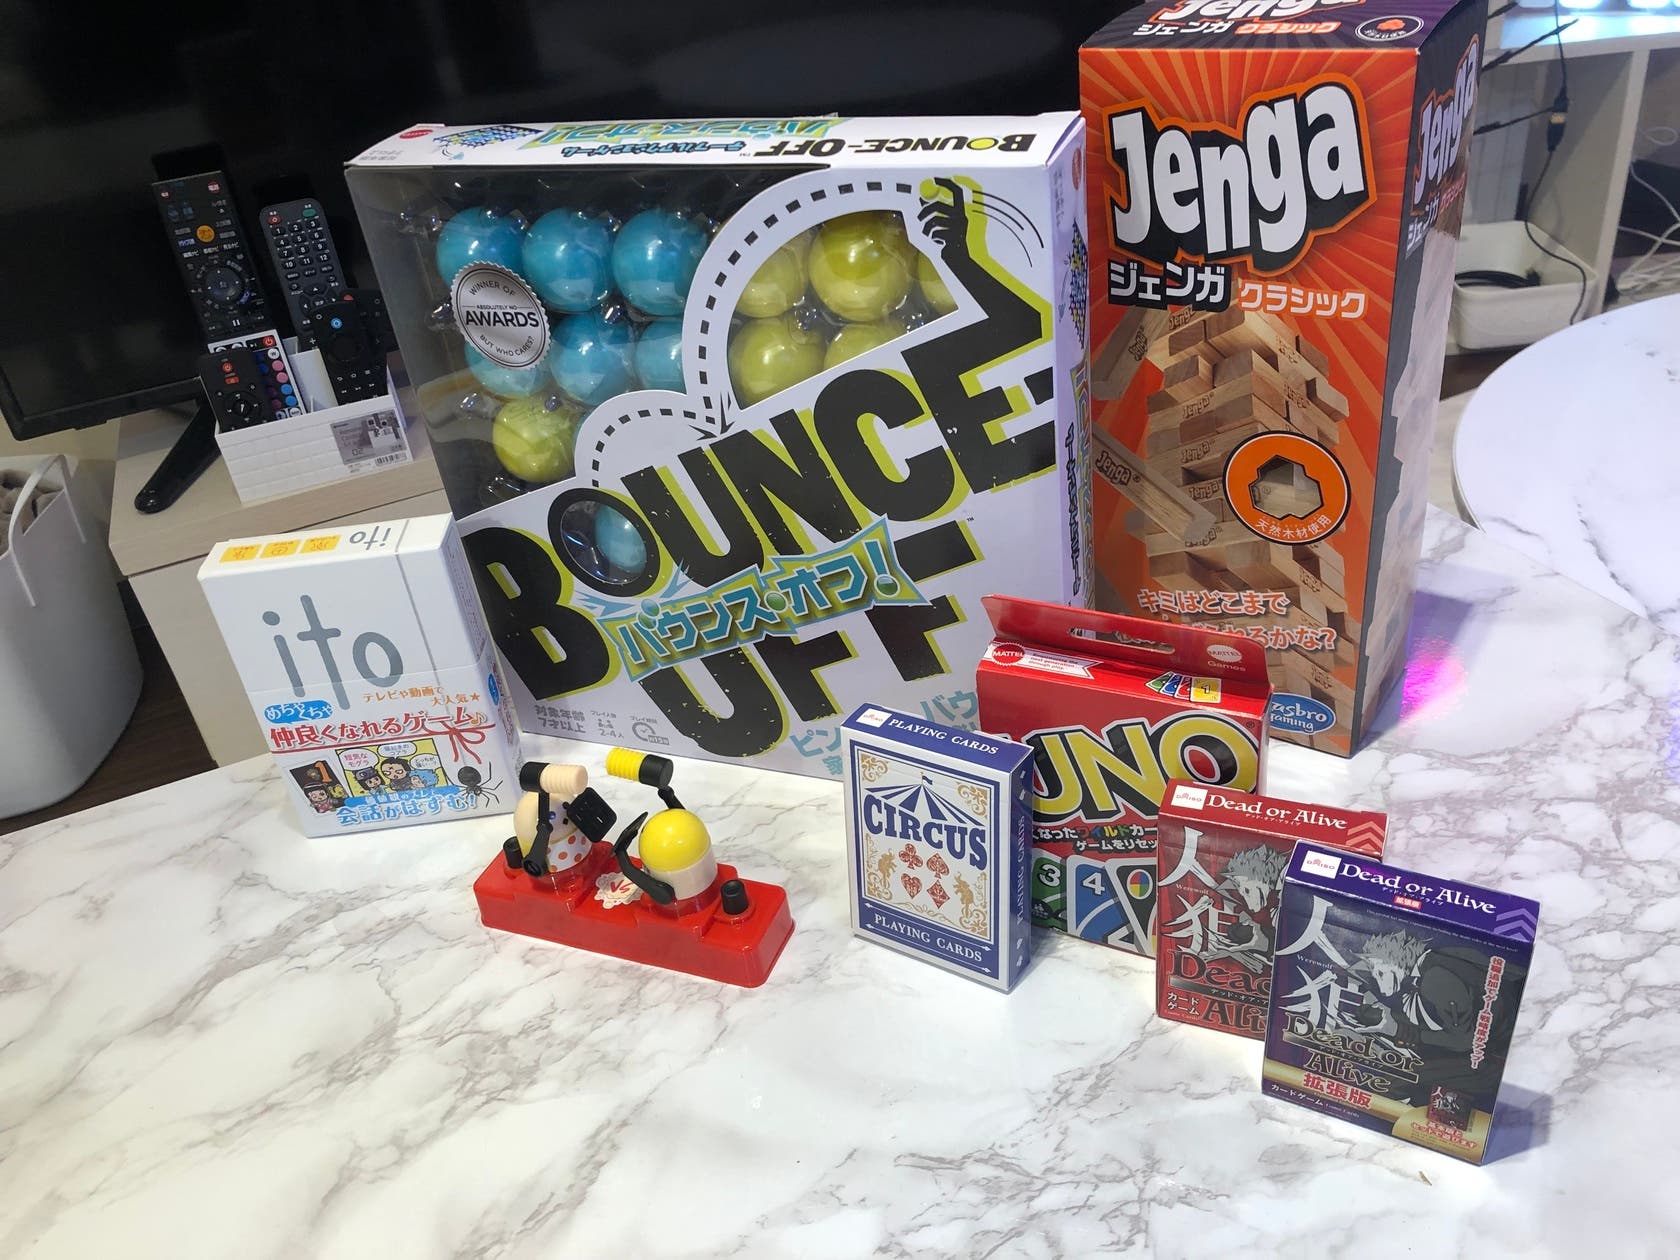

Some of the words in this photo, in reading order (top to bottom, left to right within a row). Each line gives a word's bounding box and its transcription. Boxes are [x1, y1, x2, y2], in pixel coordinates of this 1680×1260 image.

[1132, 20, 1233, 36] ジェンガ
[1414, 41, 1477, 206] Jenga
[1109, 84, 1367, 256] Jenga
[469, 280, 500, 296] WINNER
[502, 285, 517, 297] OF
[1109, 260, 1226, 305] ジェンガ
[1241, 281, 1367, 318] クラシック
[465, 310, 540, 328] AWARDS
[479, 334, 495, 348] BUT
[496, 346, 514, 357] WHO
[514, 335, 535, 357] CARES?
[1095, 450, 1132, 486] Jenga
[1189, 480, 1220, 501] Jenga
[461, 306, 1057, 702] BOUNCE
[349, 525, 392, 551] ito
[1255, 514, 1333, 539] 天然木材使用
[1137, 588, 1291, 615] キミはどこまで
[261, 594, 404, 711] ito
[1207, 660, 1246, 672] Games
[362, 686, 445, 702] テレビや動画で
[1271, 701, 1327, 723] asbro
[887, 718, 948, 740] PLAYING
[951, 735, 999, 755] CARDS
[1206, 794, 1263, 814] Dead
[1266, 807, 1292, 819] or
[1293, 809, 1348, 831] Alive
[863, 794, 988, 871] CIRCUS
[1039, 863, 1062, 888] 3
[1082, 872, 1106, 896] 4
[1339, 863, 1402, 890] Dead
[1405, 883, 1434, 896] or
[1436, 887, 1497, 914] Alive
[873, 912, 931, 943] PLAYING
[936, 936, 983, 963] CARDS
[1295, 953, 1336, 970] Werewolf
[1167, 991, 1200, 1006] カード
[1167, 1001, 1200, 1016] ゲーム
[1201, 999, 1267, 1034] Ali
[1284, 1011, 1377, 1059] Dead
[1380, 1050, 1424, 1072] or
[1271, 1084, 1324, 1107] カードゲーム
[1303, 1072, 1373, 1109] 拡張版
